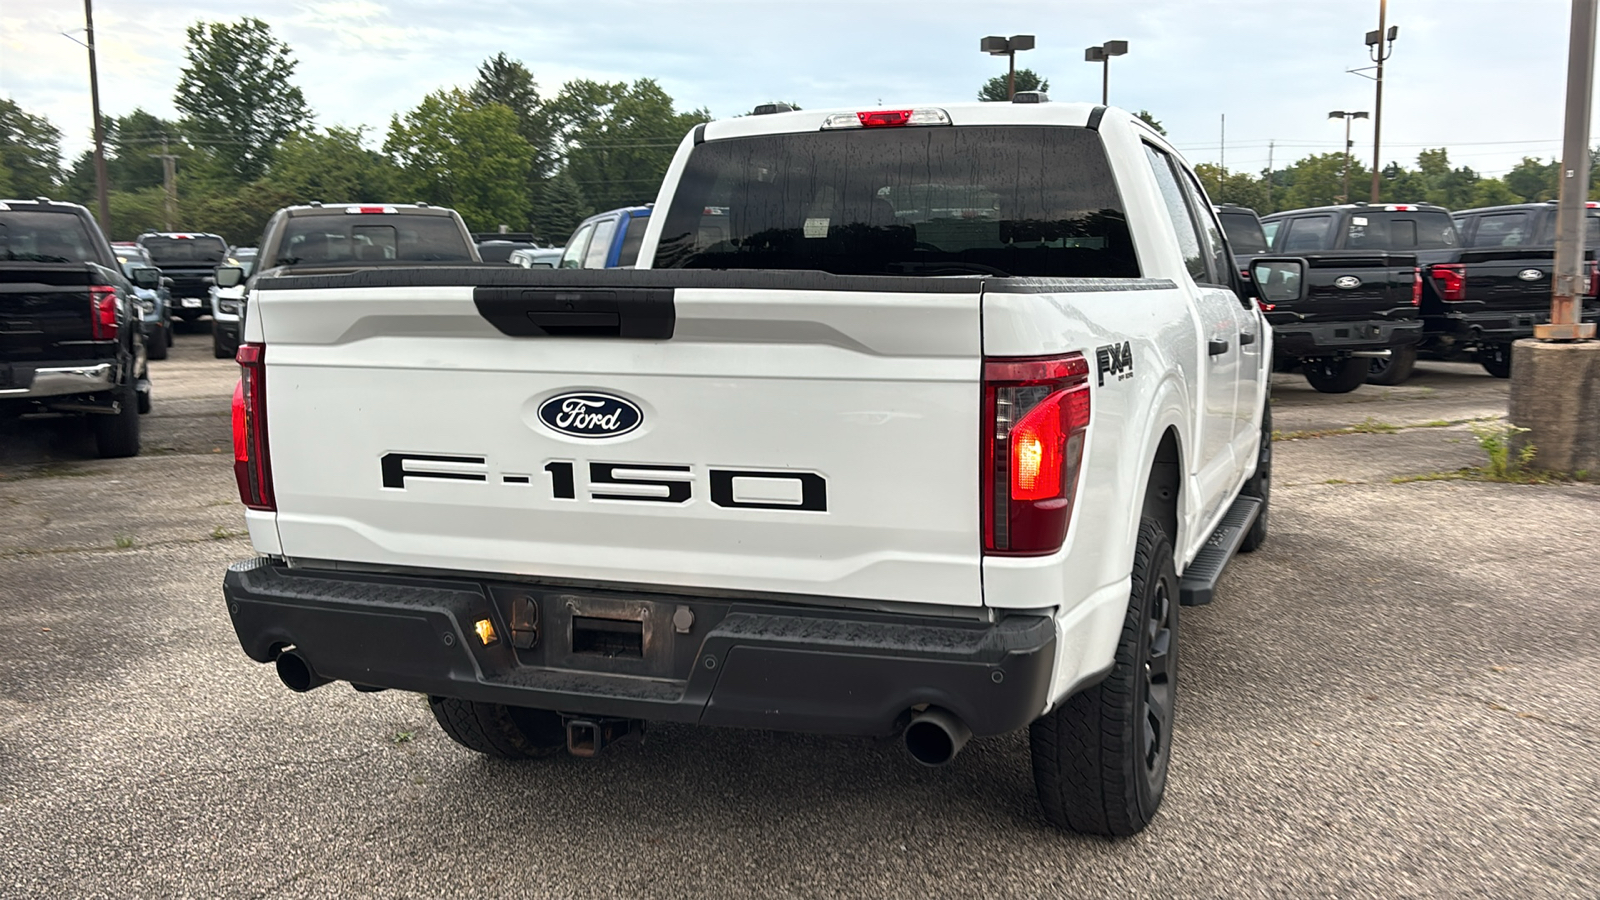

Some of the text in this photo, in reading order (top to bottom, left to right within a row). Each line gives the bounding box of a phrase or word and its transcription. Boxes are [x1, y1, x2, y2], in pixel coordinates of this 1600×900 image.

[1096, 341, 1133, 387] FX4
[556, 398, 622, 430] Ford
[380, 452, 828, 512] F-150
